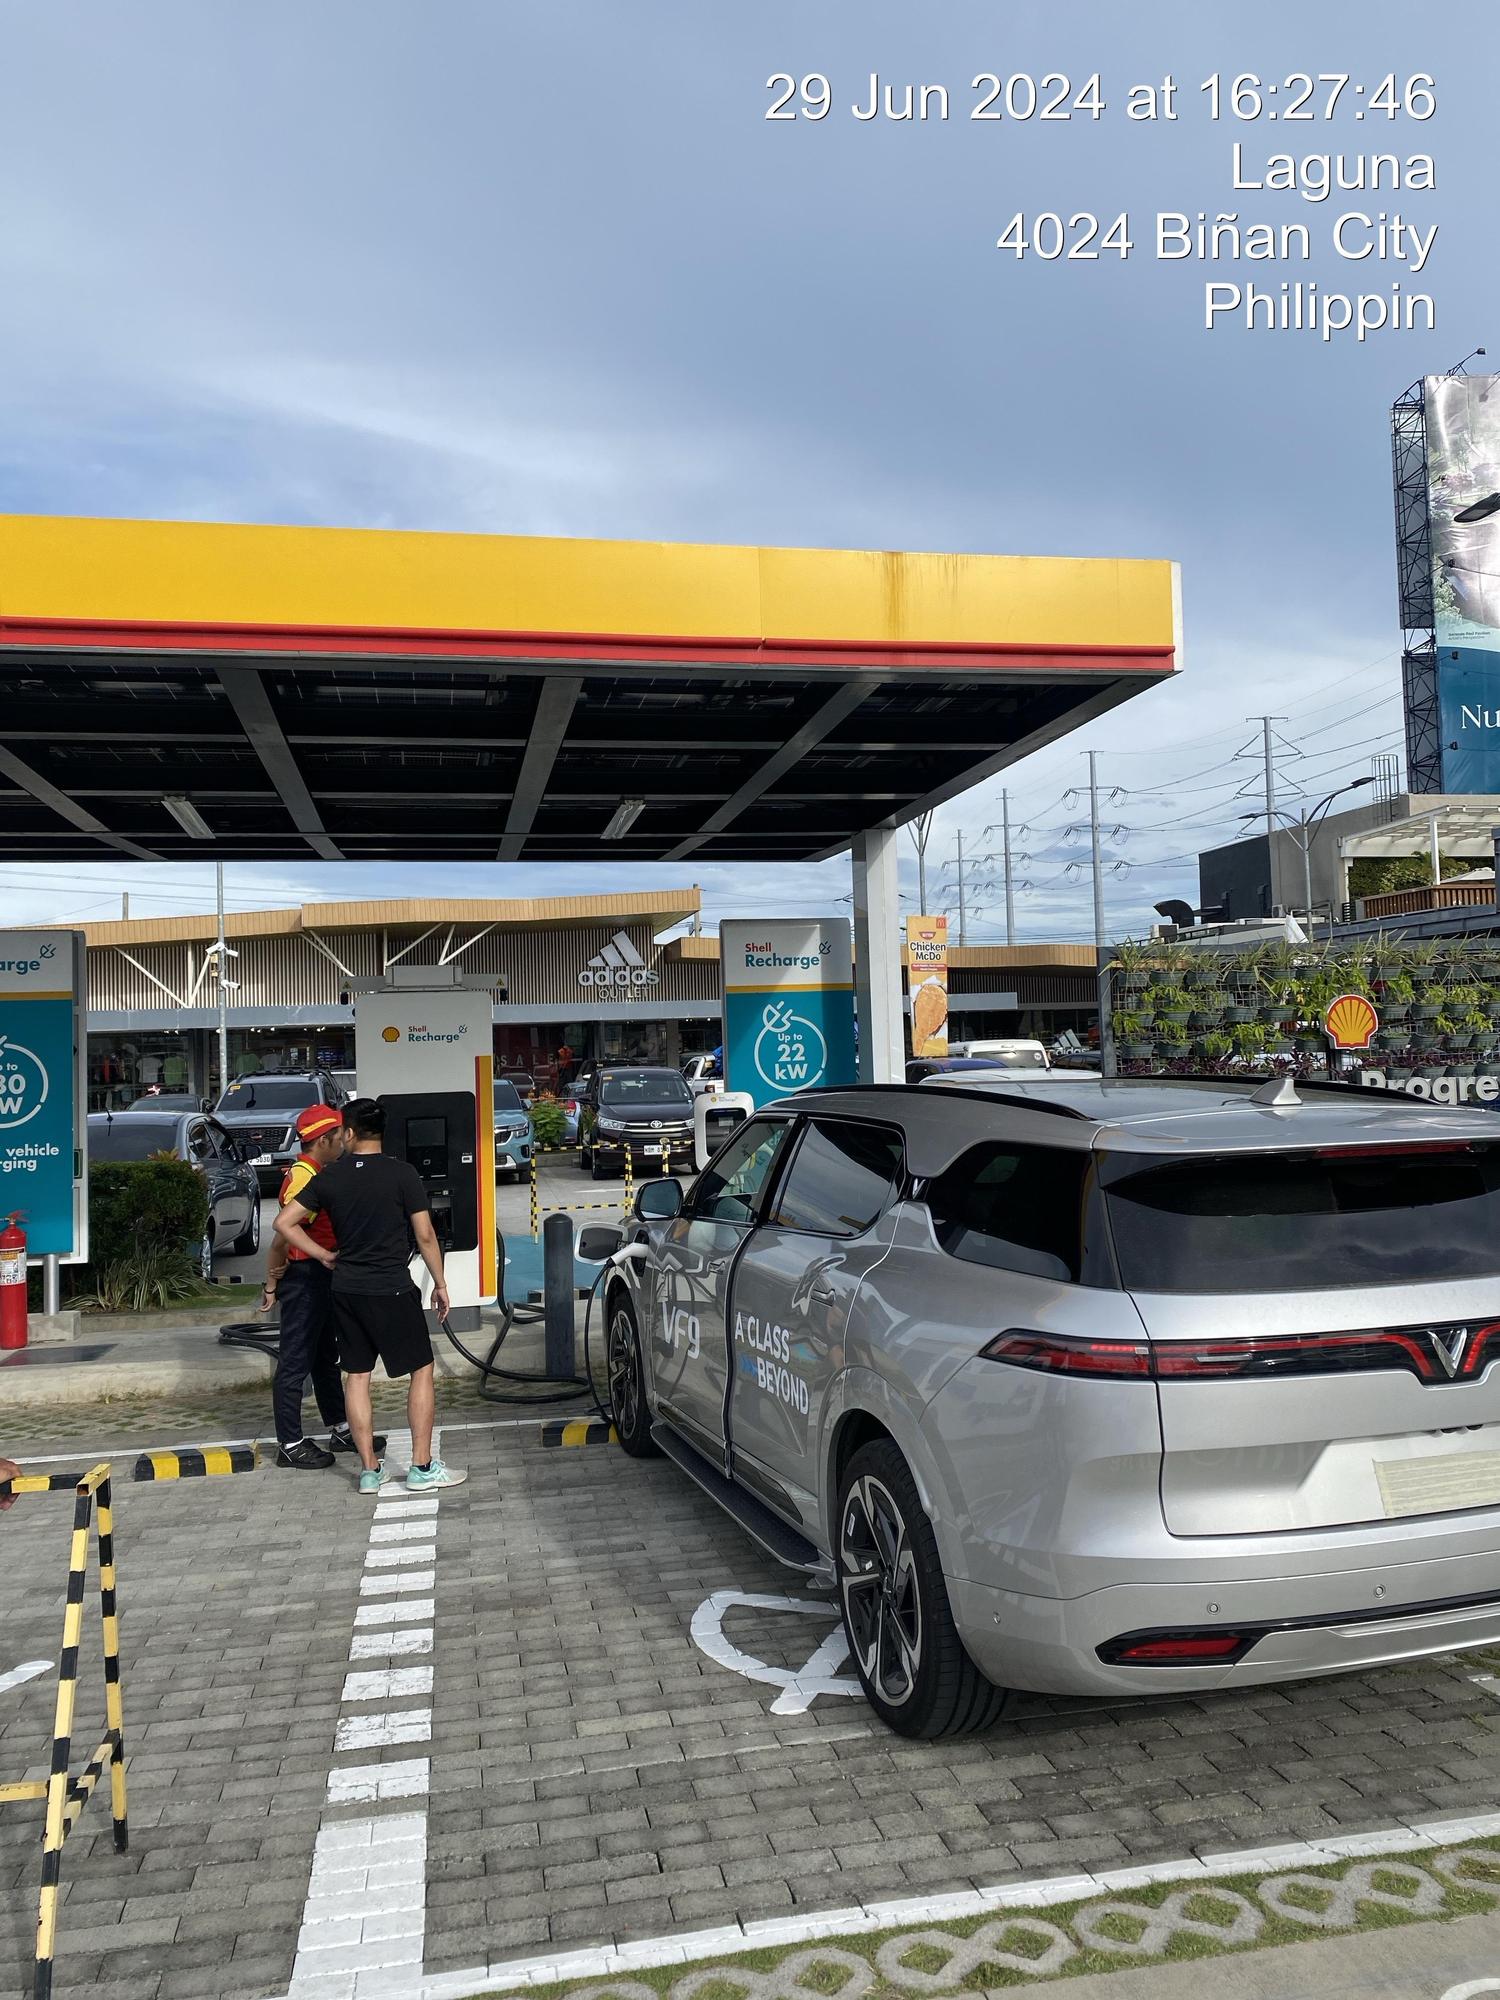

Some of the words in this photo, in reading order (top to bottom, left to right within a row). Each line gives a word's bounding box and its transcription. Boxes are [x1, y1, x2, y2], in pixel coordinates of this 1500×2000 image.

[745, 943, 772, 952] Shell
[910, 941, 946, 951] Chicken
[745, 953, 820, 969] Recharge
[916, 952, 941, 960] McDo
[578, 966, 660, 987] adidas
[599, 986, 648, 999] OUTLET
[408, 1032, 460, 1043] Recharge
[778, 1033, 791, 1043] Up
[793, 1033, 803, 1041] to
[777, 1043, 805, 1062] 22
[7, 1063, 18, 1071] to
[775, 1063, 808, 1080] kW
[5, 1143, 60, 1157] vehicle
[662, 1301, 699, 1359] VF9
[735, 1311, 744, 1343] A
[747, 1316, 790, 1364] CLASS
[757, 1356, 809, 1415] BEYOND
